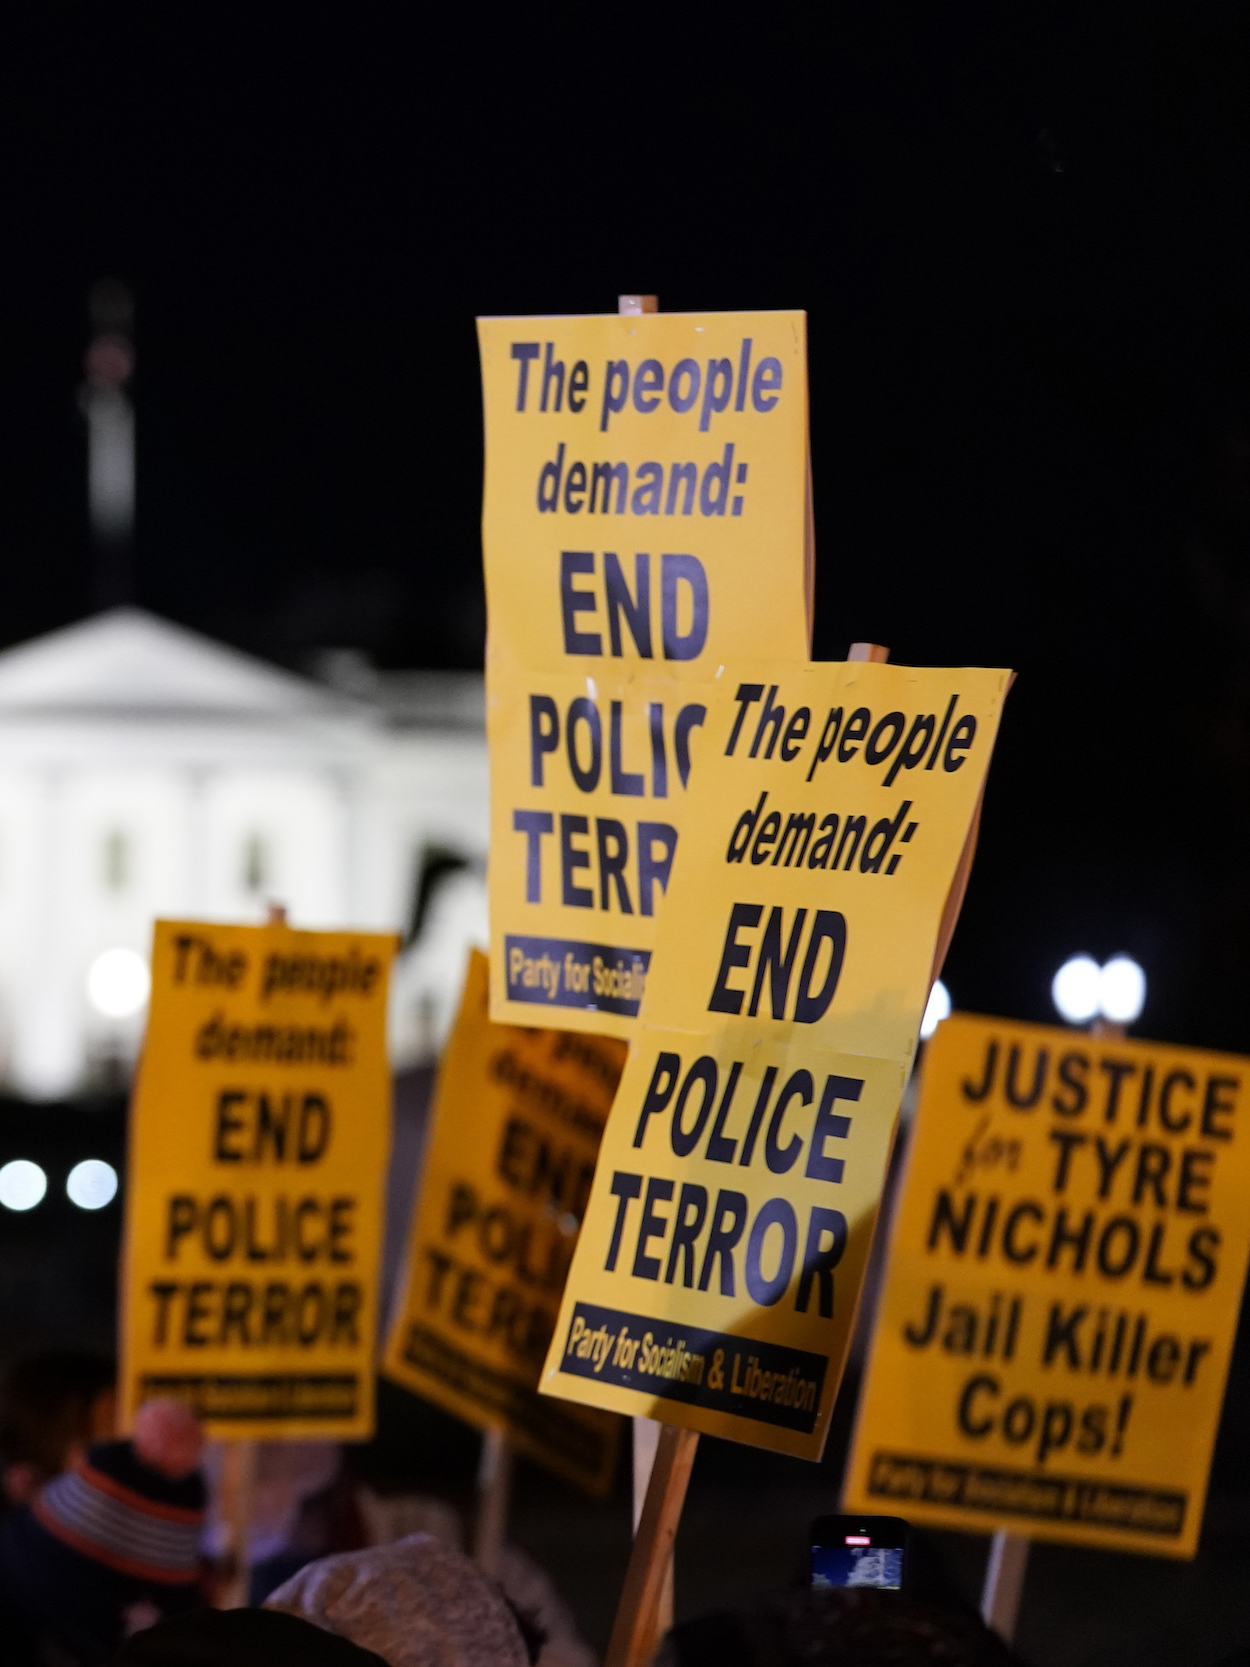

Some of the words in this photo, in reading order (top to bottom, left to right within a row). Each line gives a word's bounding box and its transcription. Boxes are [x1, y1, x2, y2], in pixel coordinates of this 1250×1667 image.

[510, 342, 588, 413] The
[600, 338, 783, 432] people
[537, 442, 748, 517] demand:
[561, 551, 710, 661] END
[529, 694, 708, 799] POLIC
[725, 684, 811, 762] The
[806, 694, 977, 787] people
[512, 809, 679, 917] TERR
[725, 791, 920, 875] demand:
[171, 935, 248, 988] The
[262, 942, 382, 1003] people
[509, 947, 560, 999] Party
[564, 952, 591, 993] for
[707, 902, 847, 1024] END
[213, 1090, 332, 1167] END
[632, 1051, 866, 1184] POLICE
[962, 1038, 1242, 1141] JUSTICE
[1048, 1129, 1216, 1219] TYRE
[165, 1193, 356, 1265] POLICE
[604, 1171, 848, 1319] TERROR
[926, 1190, 1224, 1293] NICHOLS
[149, 1277, 362, 1351] TERROR
[903, 1285, 1023, 1365] Jail
[1042, 1303, 1214, 1391] Killer
[568, 1316, 614, 1373] Party
[612, 1326, 640, 1369] for
[638, 1331, 707, 1385] Socialism
[707, 1348, 725, 1391] &
[730, 1353, 817, 1413] Liberation
[957, 1373, 1134, 1463] Cops!
